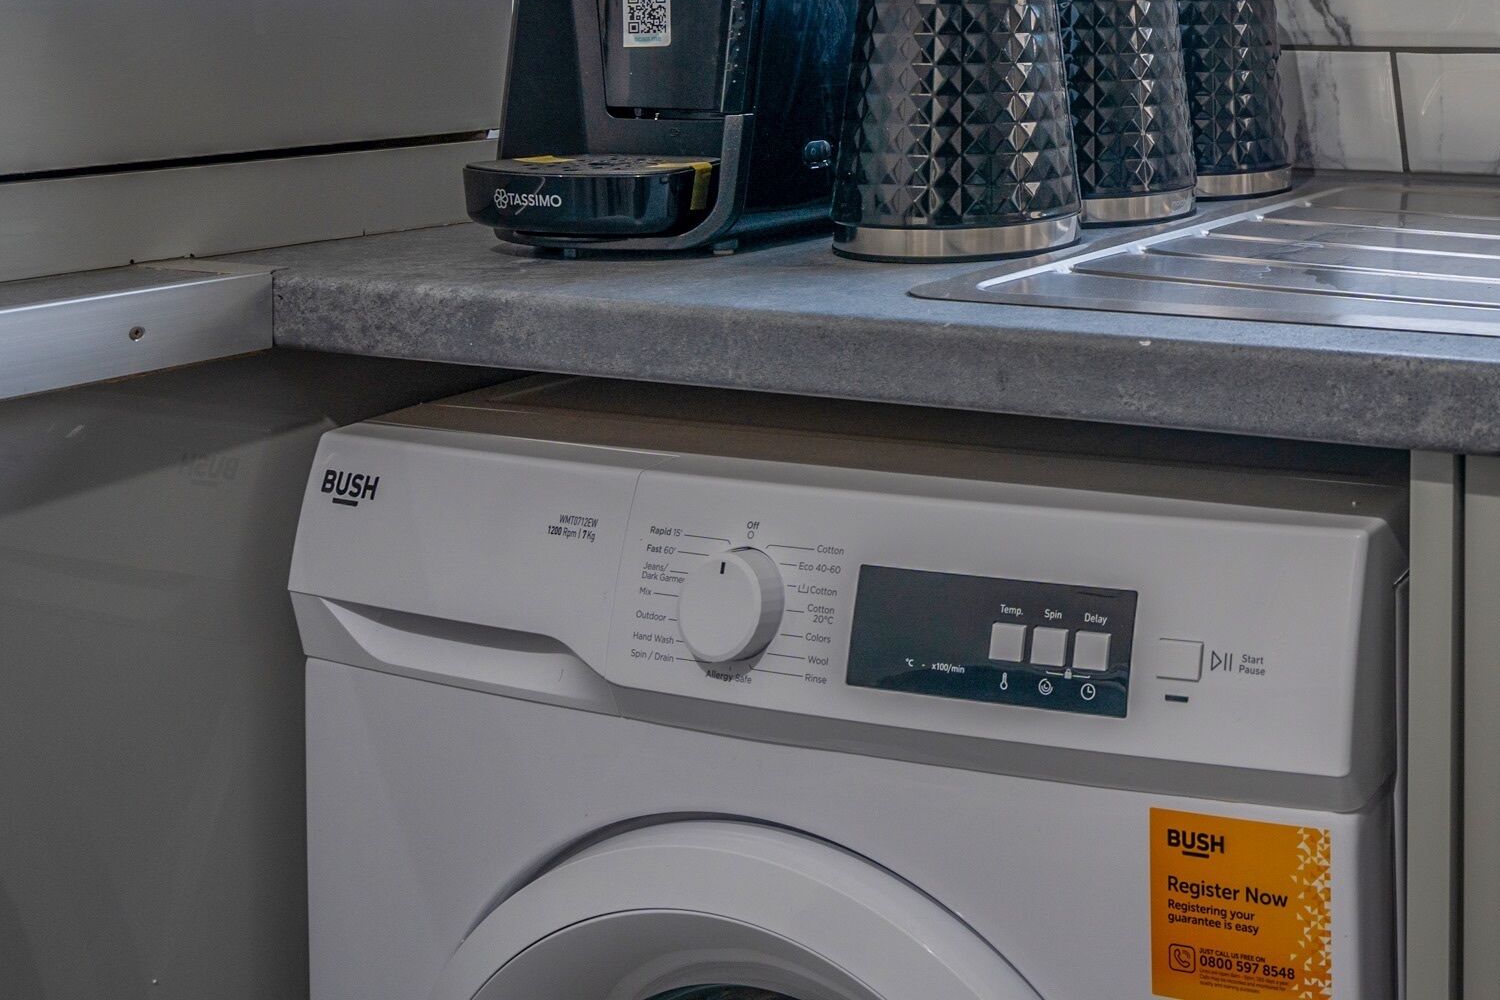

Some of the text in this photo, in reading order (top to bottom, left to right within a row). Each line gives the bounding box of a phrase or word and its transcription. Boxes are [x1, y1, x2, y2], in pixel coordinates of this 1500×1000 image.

[506, 192, 563, 208] TASSIMO
[321, 469, 381, 501] BUSH
[649, 525, 672, 537] Rapid
[746, 521, 761, 530] Off
[547, 525, 563, 536] 1200
[563, 527, 577, 540] Rpm
[646, 544, 662, 554] Fast
[816, 544, 845, 555] Cotton
[798, 561, 842, 575] Eco 40-60
[641, 571, 659, 581] Dark
[639, 586, 652, 596] Mix
[809, 585, 838, 597] Cotton
[635, 609, 667, 621] Outdoor
[807, 603, 835, 615] Cotton
[1000, 604, 1024, 617] Temp.
[1044, 608, 1063, 620] Spin
[812, 614, 834, 625] 20°C
[1084, 612, 1108, 626] Delay
[633, 631, 675, 645] Hand Wash
[805, 632, 832, 644] Colors
[630, 648, 647, 659] Spin
[654, 651, 675, 662] Drain
[807, 655, 829, 666] Wool
[1241, 654, 1264, 665] Start
[931, 662, 965, 674] x100/min
[1239, 664, 1266, 676] Pause
[705, 669, 753, 685] Allergy Safe
[804, 673, 828, 685] Rinse
[1167, 828, 1225, 854] BUSH
[1167, 875, 1289, 908] Register Now
[1167, 898, 1256, 921] Registering your
[1167, 912, 1260, 936] guarantee is easy
[1199, 947, 1214, 956] JUST
[1214, 949, 1230, 959] CALL
[1230, 952, 1240, 960] US
[1240, 953, 1255, 962] FREE
[1199, 954, 1233, 971] 0800
[1236, 960, 1260, 974] 597
[1262, 964, 1295, 980] 8548
